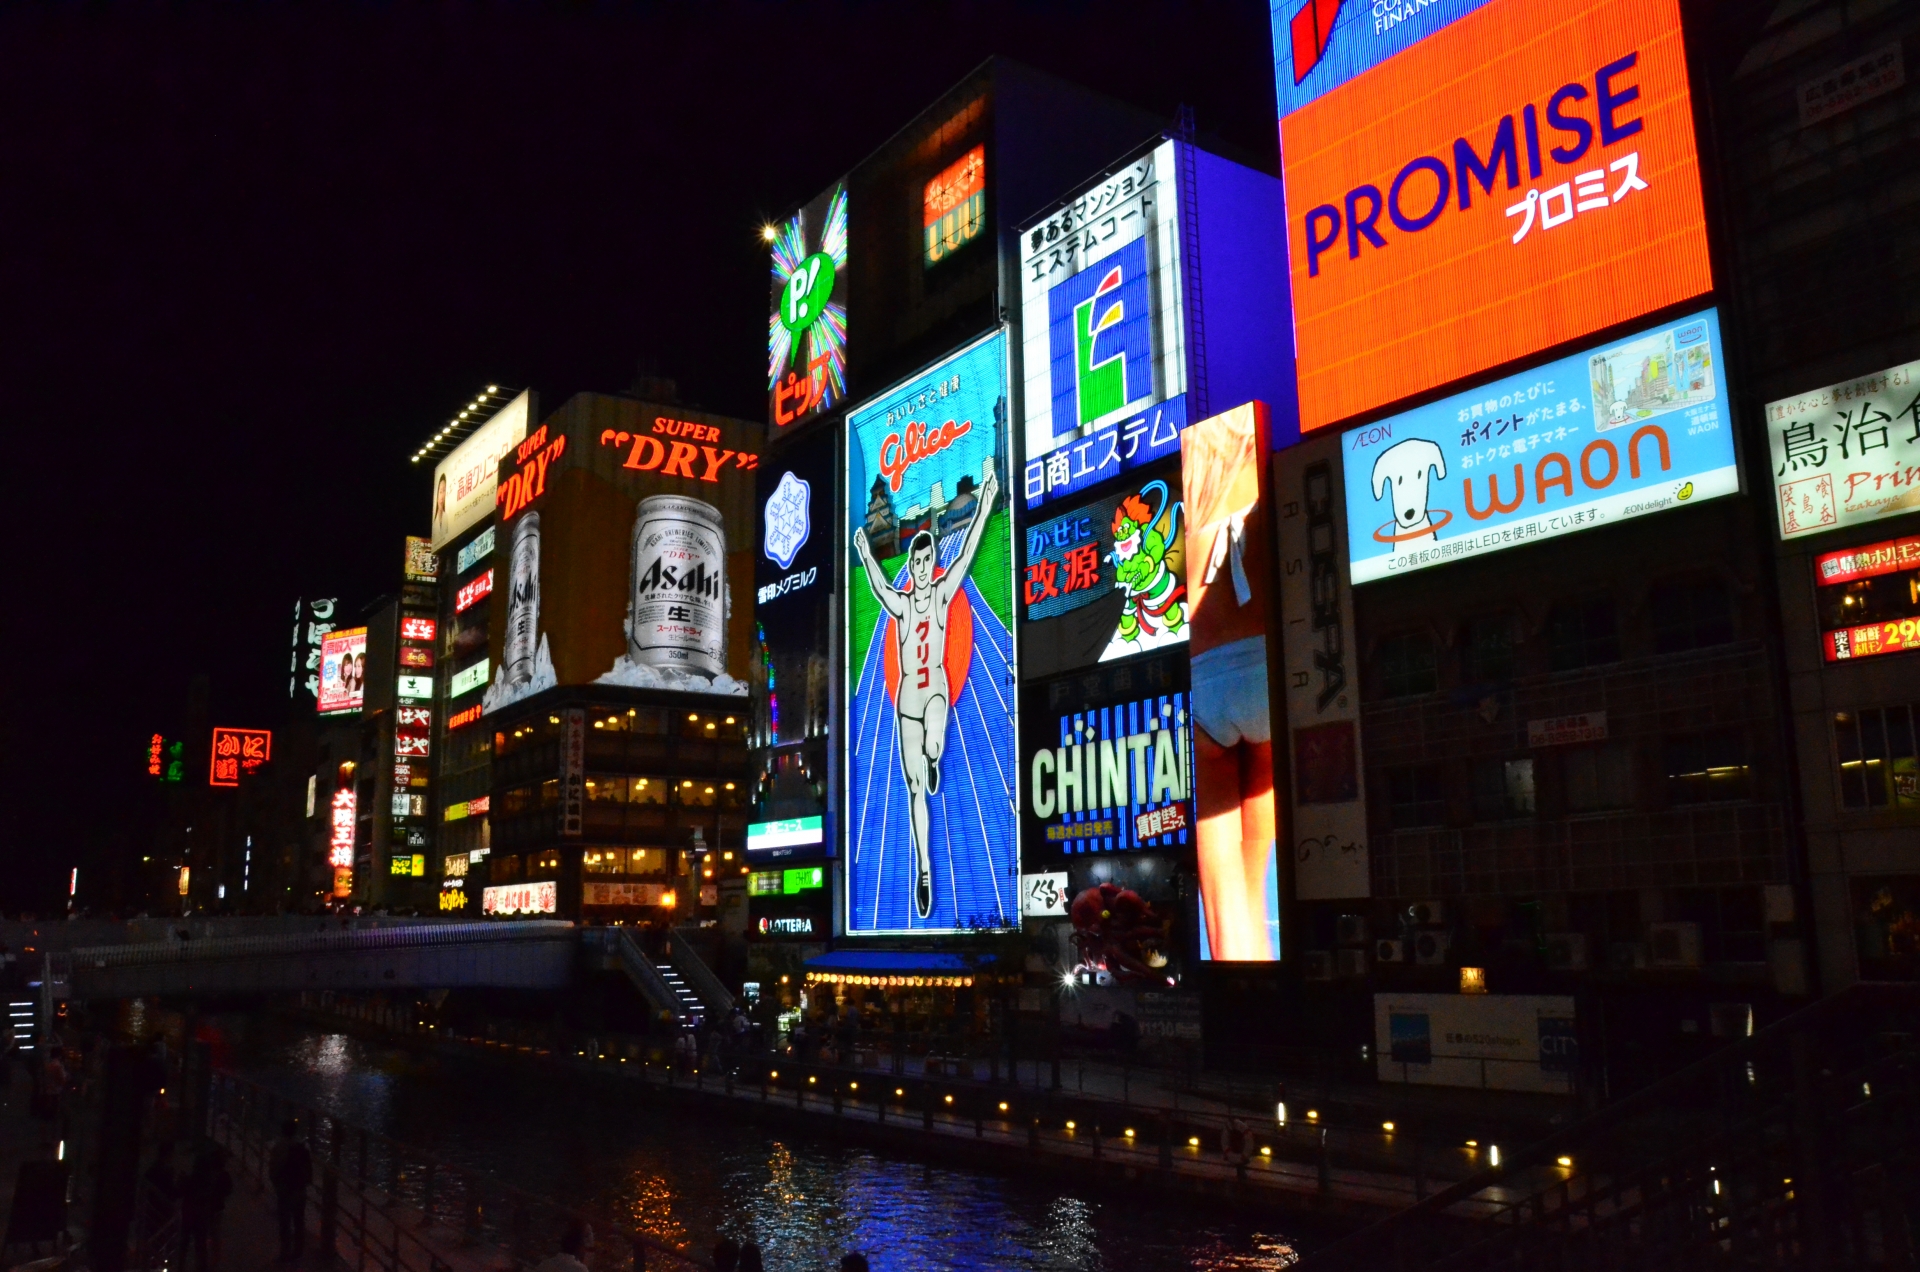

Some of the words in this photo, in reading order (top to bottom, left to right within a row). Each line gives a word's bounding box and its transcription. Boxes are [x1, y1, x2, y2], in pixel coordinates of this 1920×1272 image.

[1304, 50, 1644, 279] PROMISE
[1030, 163, 1154, 250] 夢あるマンション
[1505, 151, 1649, 245] プロミス
[1031, 196, 1154, 283] エステムコート
[774, 350, 832, 426] ピップ
[886, 374, 961, 427] おいしさと健康
[1456, 380, 1557, 423] お買物のたびに
[653, 416, 722, 444] SUPER
[1460, 398, 1587, 447] ポイントがたまる、
[1687, 421, 1719, 436] WAON
[516, 424, 548, 465] SUPER
[879, 417, 972, 493] Glico
[1024, 409, 1180, 500] 日商エステム
[1460, 424, 1580, 470] おトクな電子マネー
[1463, 423, 1672, 521] WAON
[1644, 495, 1673, 512] delight
[1844, 493, 1901, 513] izakaya
[1030, 516, 1092, 556] かぜに
[1387, 506, 1607, 571] この看板の照明はLEDを使用しています。
[639, 555, 719, 601] Asahi
[757, 566, 818, 605] 雪印メグミルク
[1023, 541, 1101, 606] 改源
[656, 624, 703, 637] スーパードライ
[667, 605, 692, 623] 生
[1853, 625, 1881, 643] 新鮮
[1883, 618, 1920, 646] 29
[668, 649, 689, 661] 350ml
[914, 614, 931, 690] グリコ
[1853, 639, 1883, 656] ホルモン
[398, 707, 430, 726] はや
[217, 733, 265, 759] かに
[396, 736, 429, 754] はや
[1031, 726, 1188, 819] CHINTAI
[1046, 819, 1114, 843] 毎週水曜日発売
[1136, 811, 1163, 841] 賃貸
[1162, 813, 1187, 832] ニュース
[1030, 878, 1060, 910] くくる
